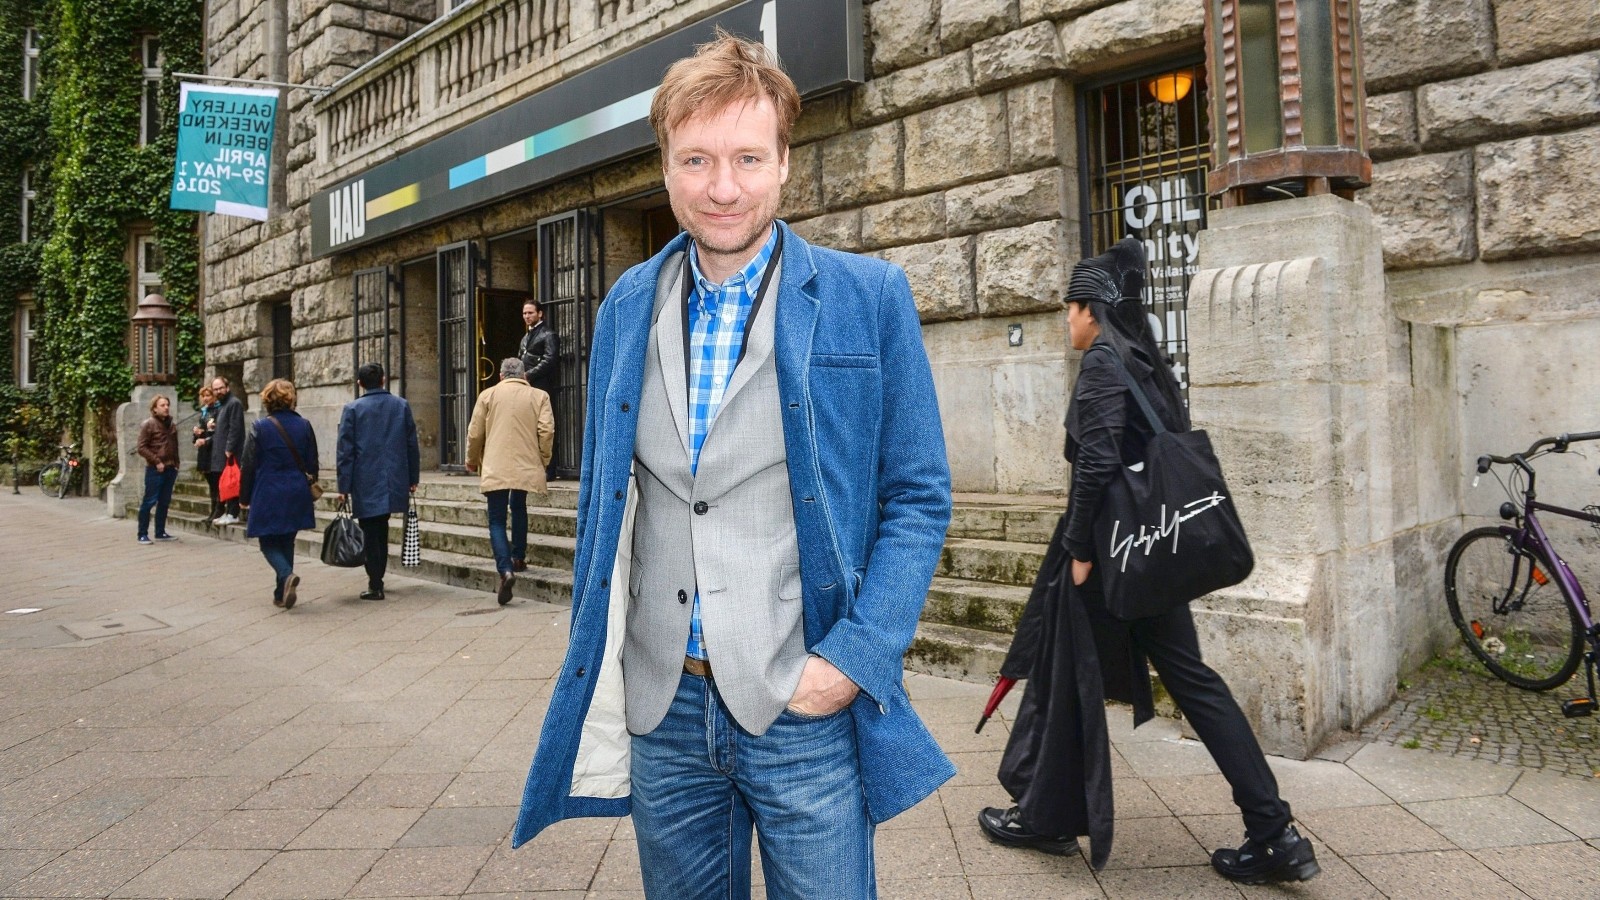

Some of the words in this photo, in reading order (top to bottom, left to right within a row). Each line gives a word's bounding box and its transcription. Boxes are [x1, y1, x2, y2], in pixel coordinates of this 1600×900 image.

[329, 178, 365, 247] HAU
[1124, 177, 1200, 229] OIL
[1126, 229, 1200, 263] nity
